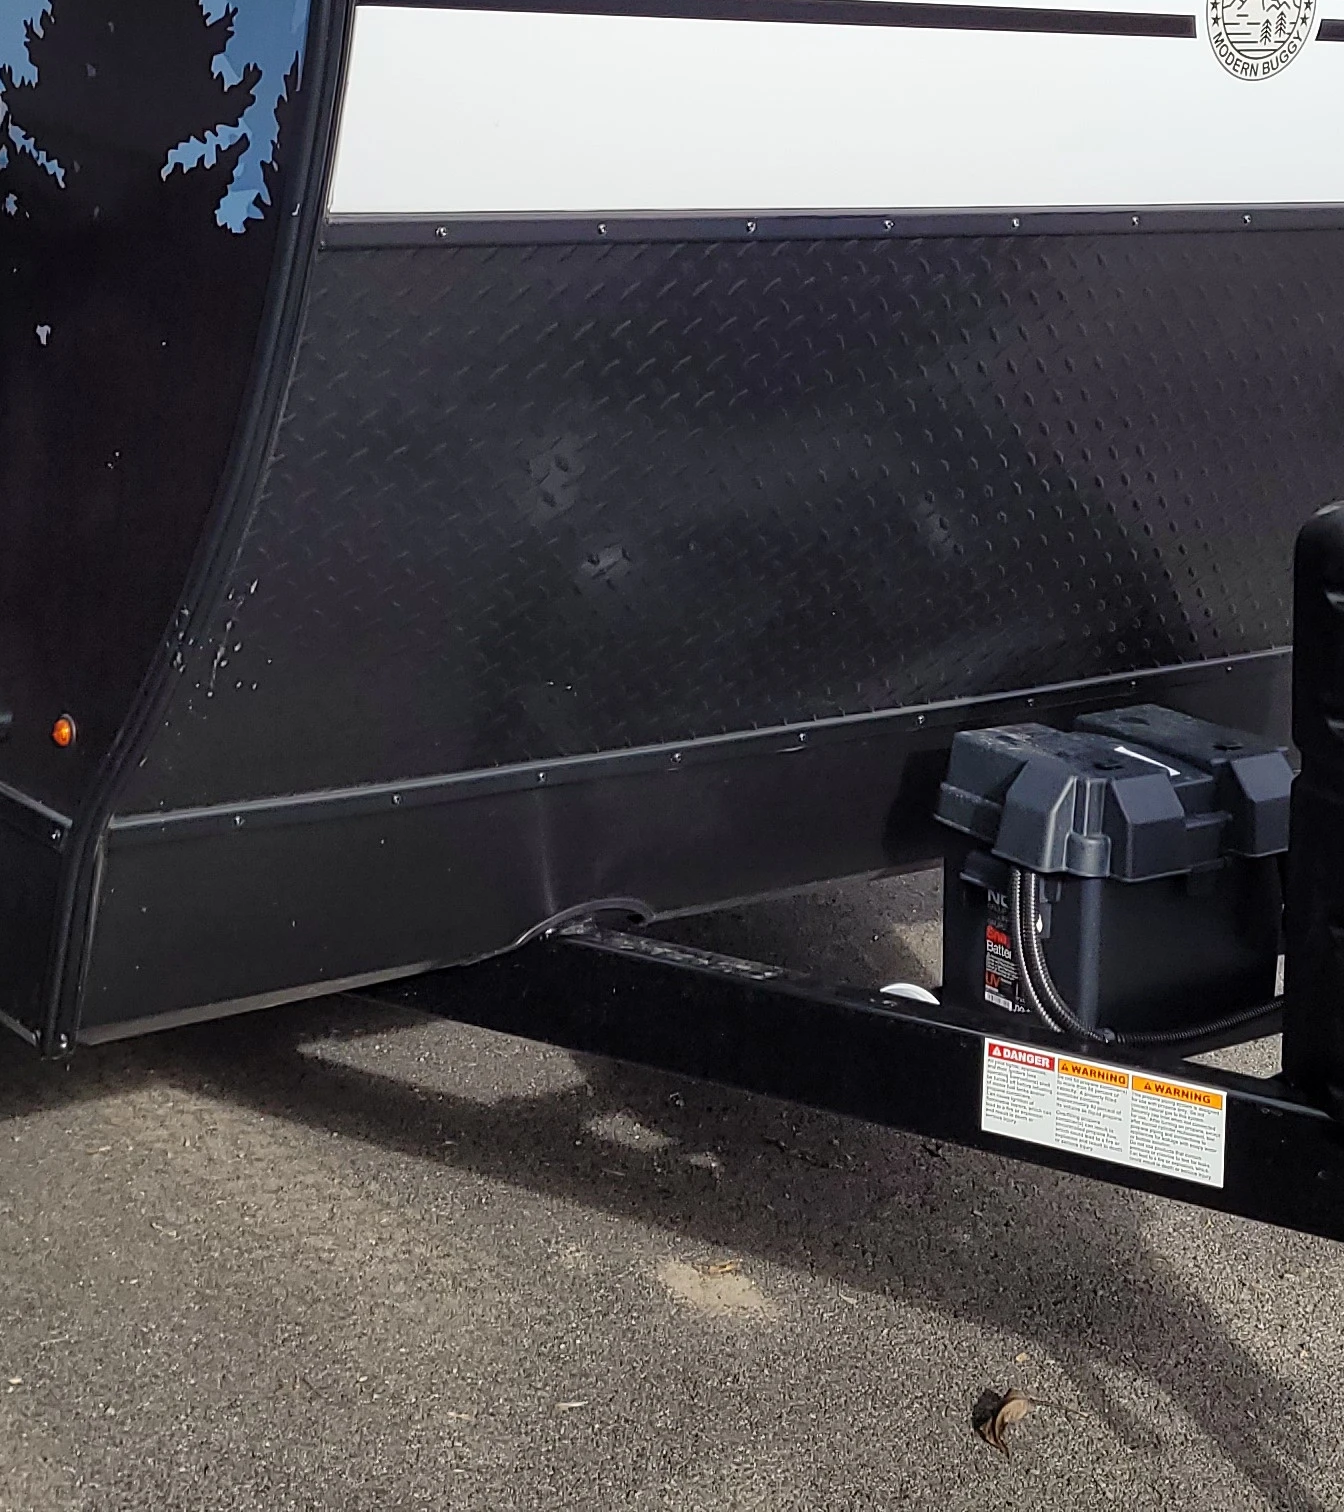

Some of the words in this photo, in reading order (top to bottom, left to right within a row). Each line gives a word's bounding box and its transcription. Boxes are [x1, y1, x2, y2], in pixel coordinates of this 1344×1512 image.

[1213, 31, 1259, 77] MODERN
[1262, 29, 1303, 75] BUGGY
[1002, 1047, 1051, 1069] DANGER
[1071, 1064, 1126, 1085] WARNING
[1154, 1083, 1211, 1104] WARNING
